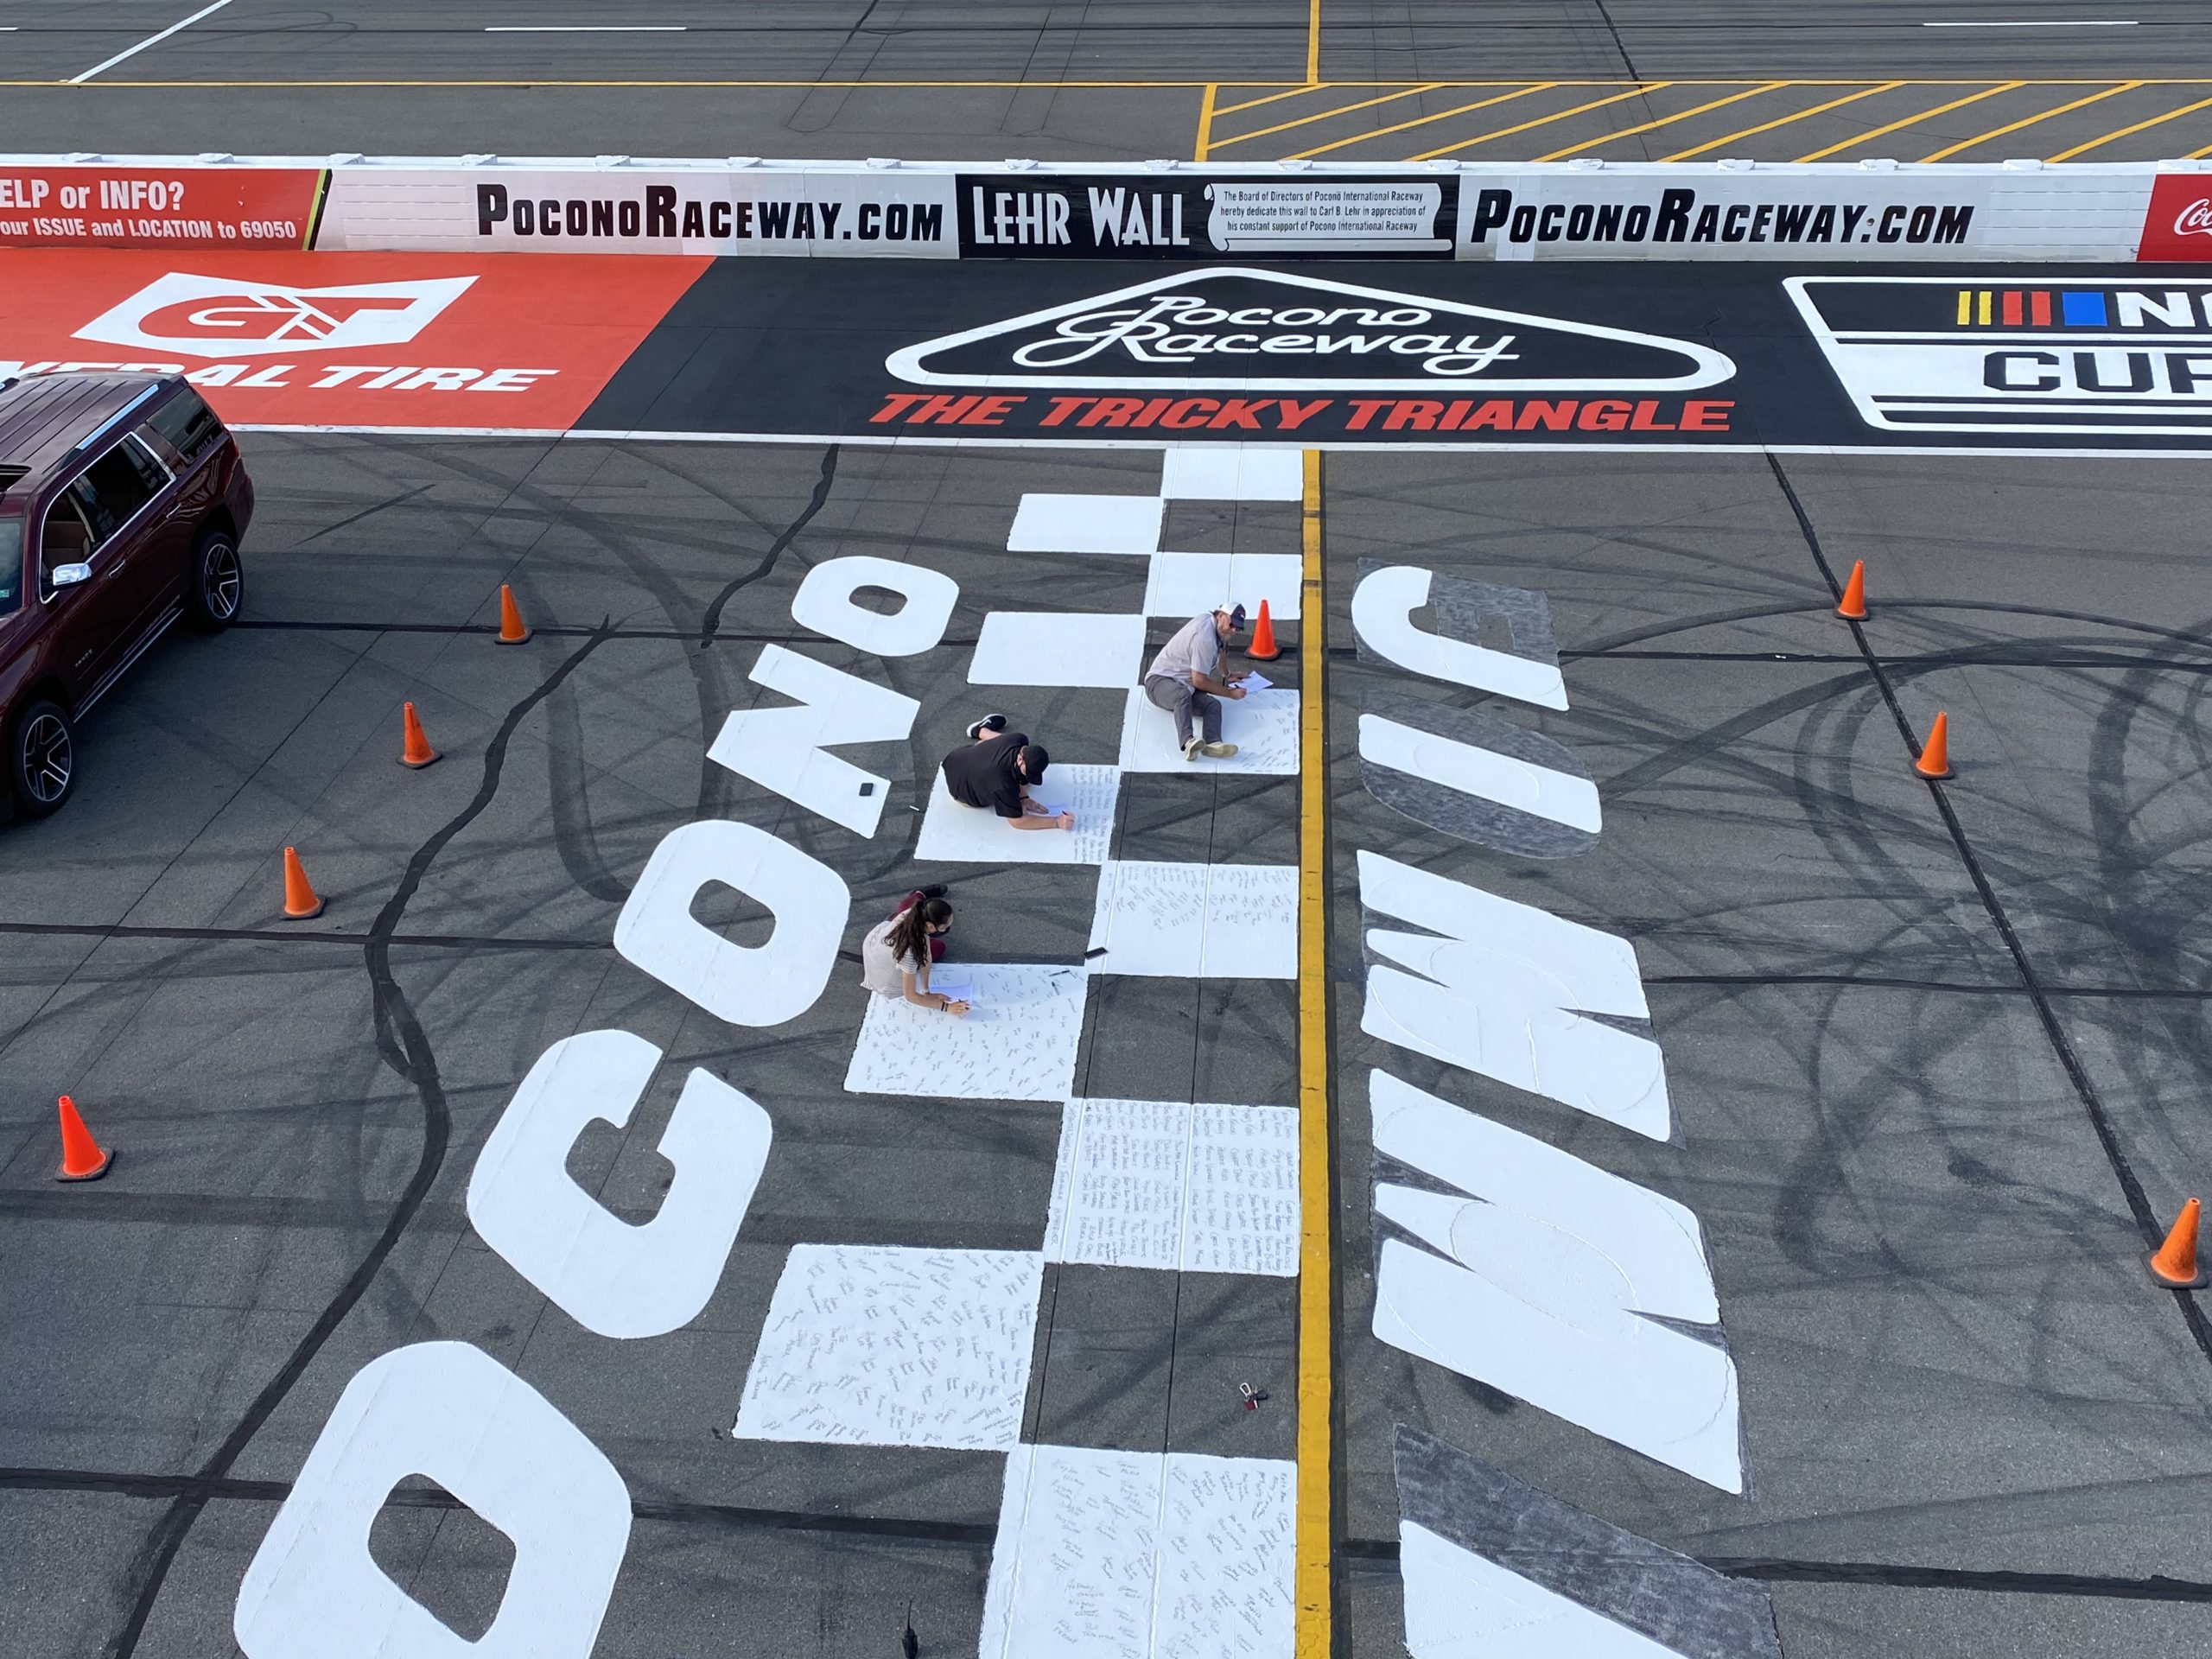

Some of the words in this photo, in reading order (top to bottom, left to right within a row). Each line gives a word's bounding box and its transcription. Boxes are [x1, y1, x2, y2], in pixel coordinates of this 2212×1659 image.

[60, 186, 90, 209] or
[99, 180, 185, 211] INFO?
[1224, 191, 1236, 201] The
[1239, 191, 1260, 201] Board
[1262, 191, 1269, 201] of
[1271, 191, 1303, 201] Directors
[1306, 191, 1313, 201] of
[1314, 191, 1341, 201] Pocono
[1344, 191, 1389, 201] International
[1391, 191, 1423, 203] Raceway
[973, 186, 1071, 245] LEHR
[1088, 187, 1190, 247] WALL
[1220, 206, 1244, 218] hereby
[1246, 206, 1277, 216] dedicate
[1279, 206, 1292, 216] this
[1294, 206, 1308, 216] wall
[1310, 207, 1316, 216] to
[1319, 206, 1334, 216] Carl
[1344, 206, 1361, 216] Lehr
[1363, 206, 1370, 216] in
[1371, 206, 1416, 218] appreciation
[1418, 206, 1427, 216] of
[1227, 220, 1237, 232] his
[1239, 220, 1270, 231] constant
[1272, 221, 1299, 232] support
[1300, 220, 1308, 232] of
[1310, 220, 1336, 232] Pocono
[1338, 220, 1384, 232] International
[1386, 220, 1418, 232] Raceway
[1, 221, 29, 236] our
[33, 218, 87, 236] ISSUE
[91, 219, 125, 238] and
[128, 219, 213, 239] LOCATION
[218, 221, 237, 239] to
[239, 220, 297, 239] 69050
[1122, 296, 1432, 327] Pocono
[1013, 309, 1520, 375] Raceway
[308, 365, 560, 392] TIRE
[868, 394, 1028, 424] THE
[1039, 397, 1344, 430] TRICKY
[1346, 399, 1735, 433] TRIANGLE
